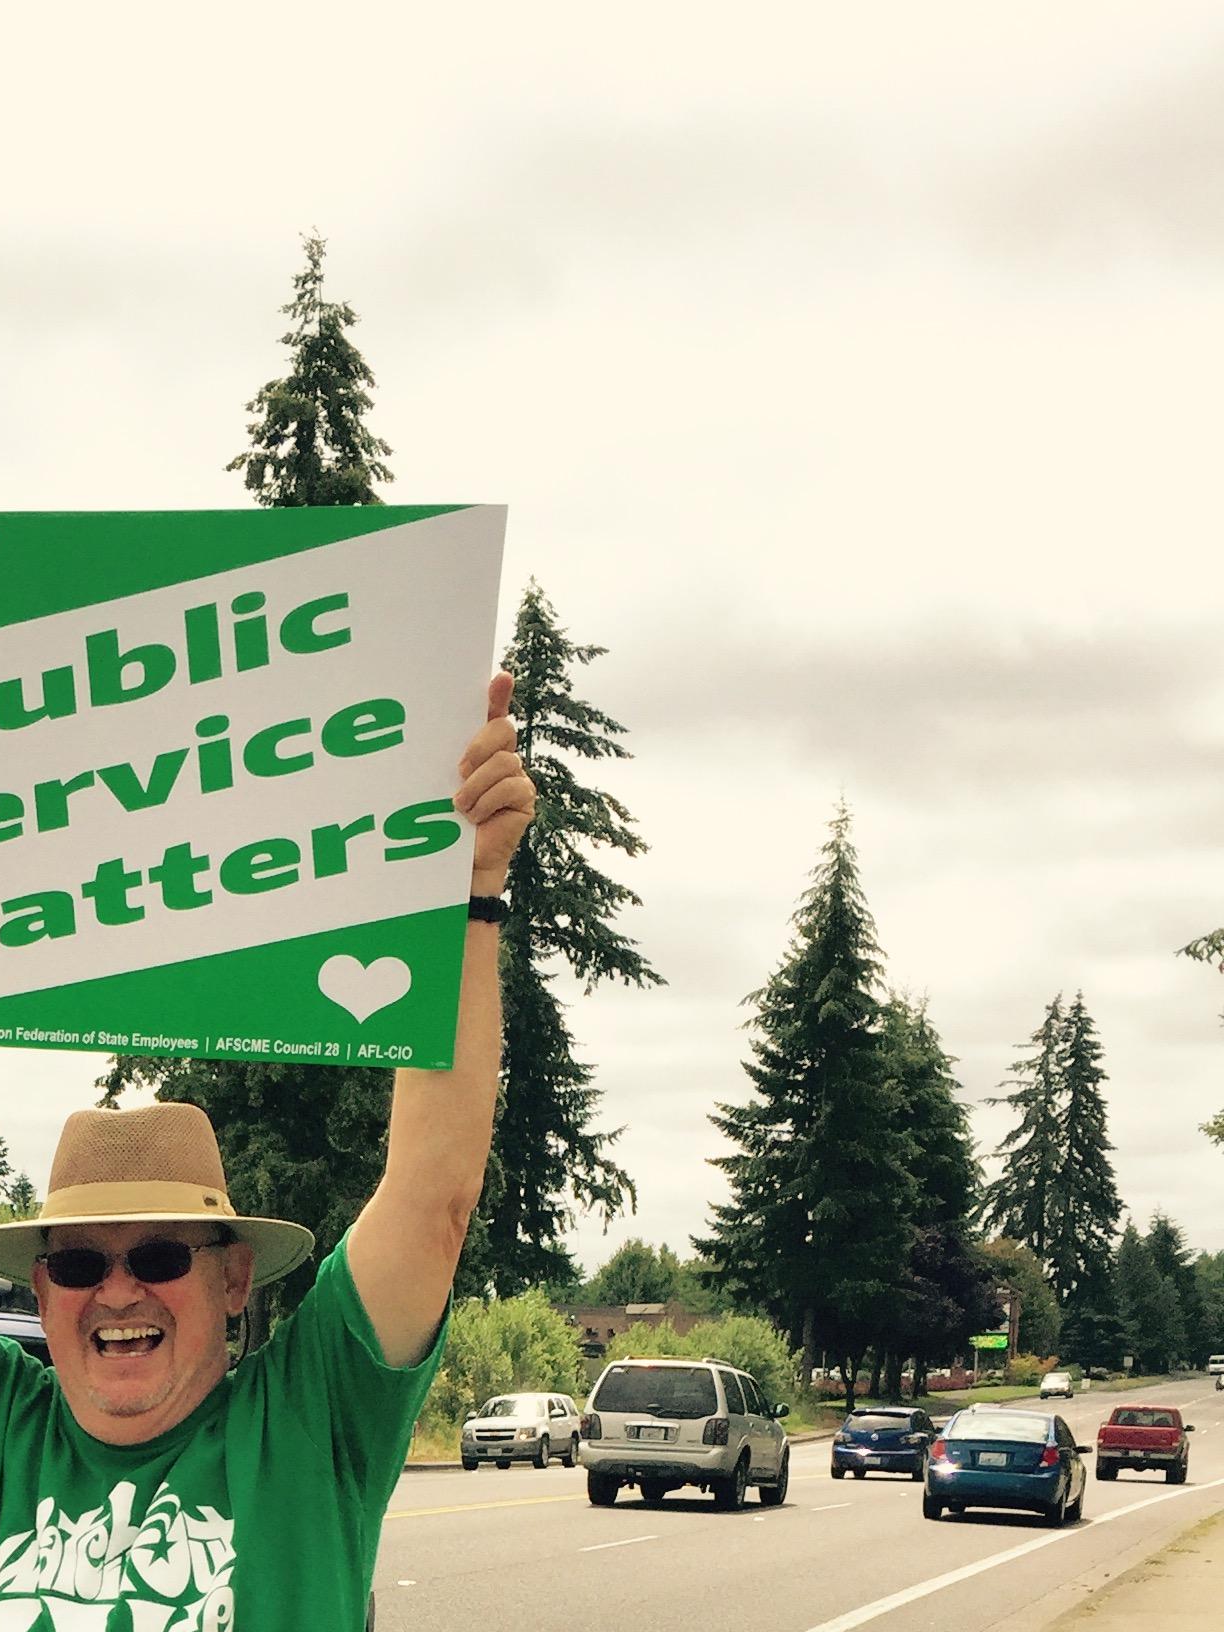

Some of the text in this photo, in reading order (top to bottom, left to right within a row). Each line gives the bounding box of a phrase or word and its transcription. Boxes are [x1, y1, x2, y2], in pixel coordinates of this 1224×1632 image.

[15, 1026, 80, 1044] Federation
[82, 1030, 95, 1045] of
[97, 1031, 129, 1047] State
[132, 1032, 199, 1051] Employees
[215, 1037, 270, 1054] AFSCME
[273, 1040, 322, 1056] Council
[324, 1042, 340, 1057] 28
[357, 1045, 413, 1061] AFL-CIO
